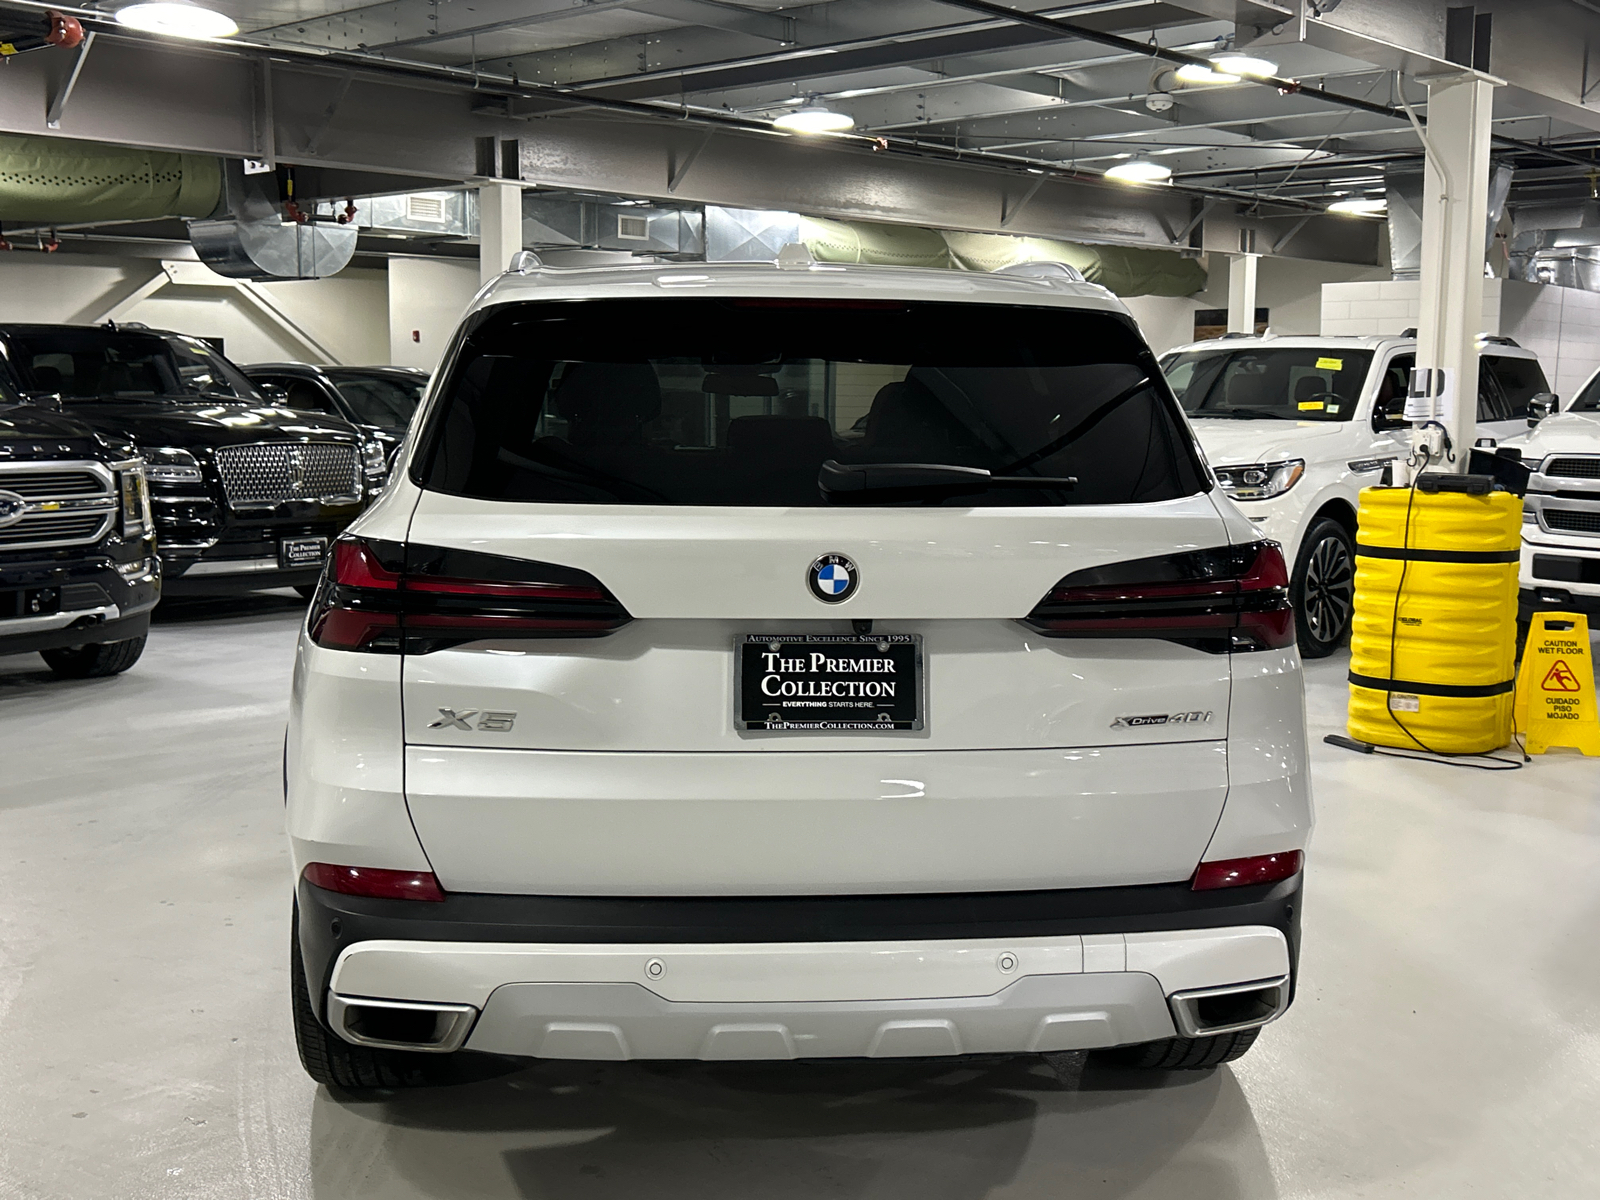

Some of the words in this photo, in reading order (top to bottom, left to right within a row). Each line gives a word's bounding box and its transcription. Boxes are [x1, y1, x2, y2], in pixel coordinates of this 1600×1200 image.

[813, 555, 856, 572] BMW
[748, 634, 803, 643] AUTOMOTIVE
[806, 634, 857, 643] EXCELLENCE
[859, 634, 885, 643] SINCE
[887, 634, 910, 643] 1995
[1544, 640, 1578, 648] CAUTION
[1538, 647, 1555, 655] WET
[761, 652, 806, 673] THE
[809, 652, 896, 673] PREMIER
[761, 674, 897, 697] COLLECTION
[1546, 697, 1580, 705] CUIDADO
[1553, 705, 1572, 713] PISO
[427, 706, 518, 732] X5
[1547, 712, 1579, 720] MOJADO
[764, 721, 895, 730] THEPREMIERCOLLECTION.COM
